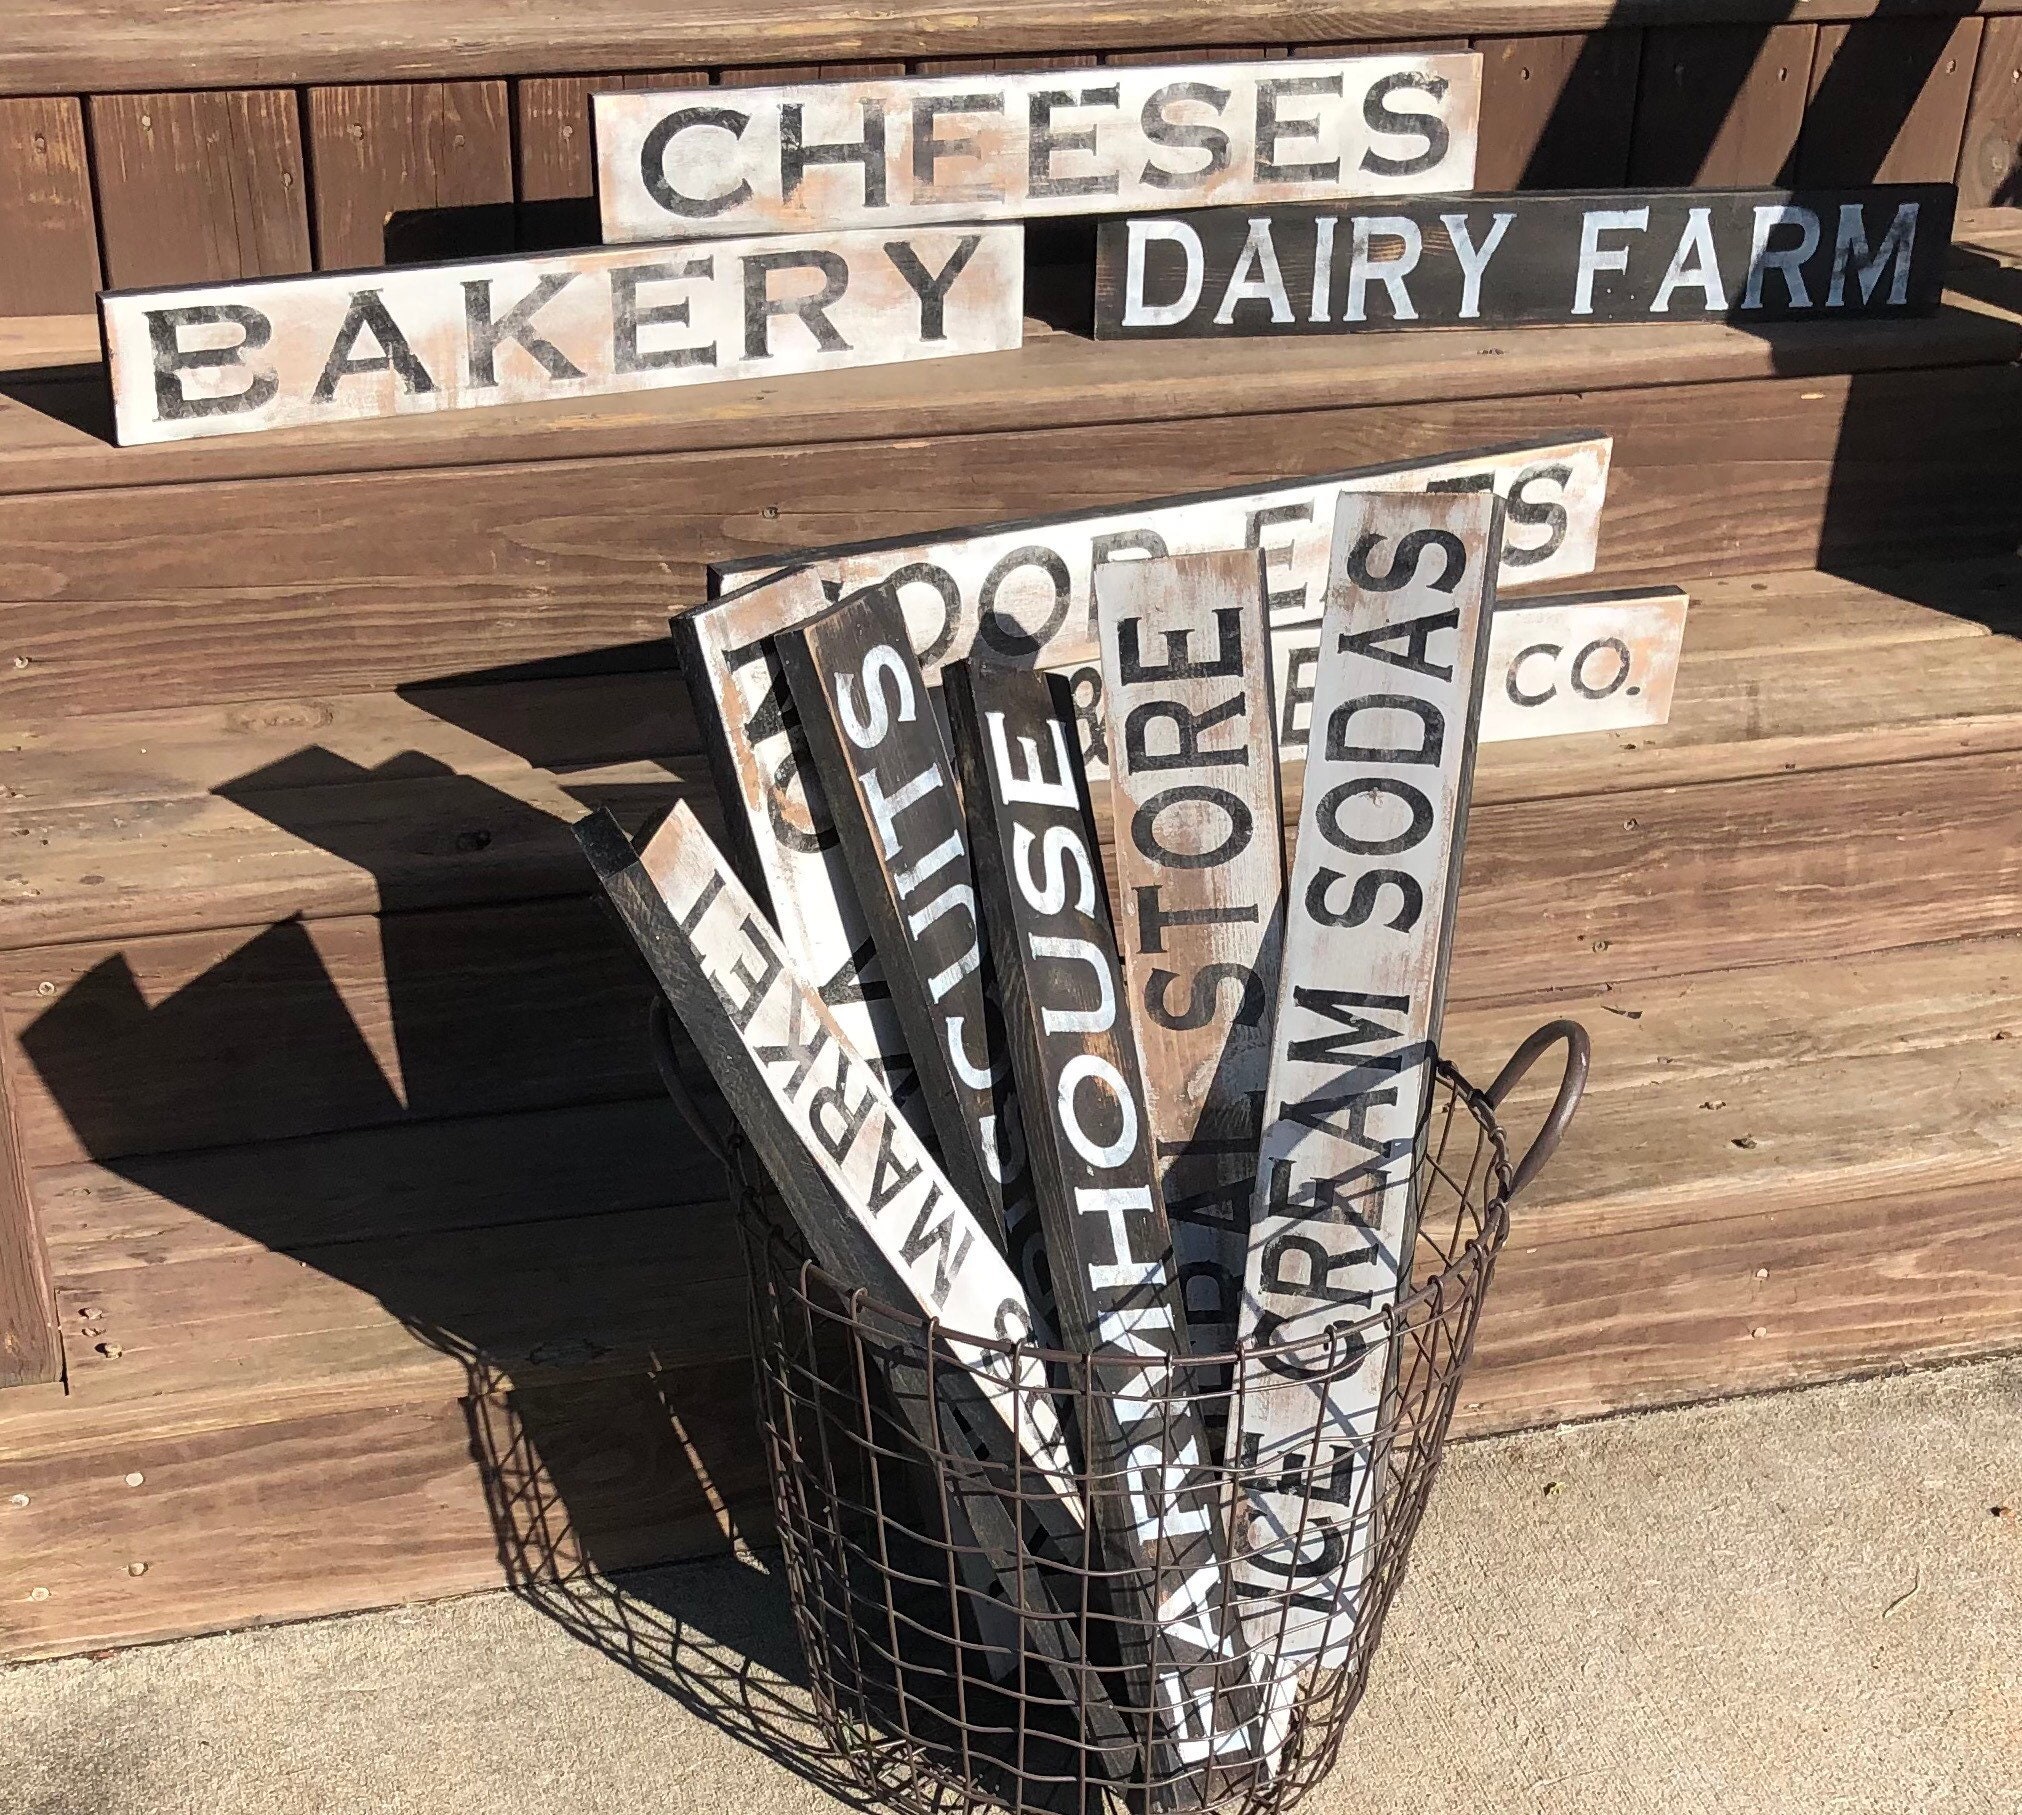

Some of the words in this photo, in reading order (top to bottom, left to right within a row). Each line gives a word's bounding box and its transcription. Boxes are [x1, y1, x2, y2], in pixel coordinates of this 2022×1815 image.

[640, 71, 1452, 218] CHEESES
[1121, 212, 1517, 328] DAIRY
[1571, 201, 1921, 316] FARM
[142, 234, 983, 423] BAKERY
[1117, 606, 1267, 1032] STORE
[1304, 527, 1469, 934] SODAS
[1505, 637, 1642, 708] CO.
[986, 712, 1252, 1764] FARMHOUSE
[1256, 985, 1412, 1383] CREAM
